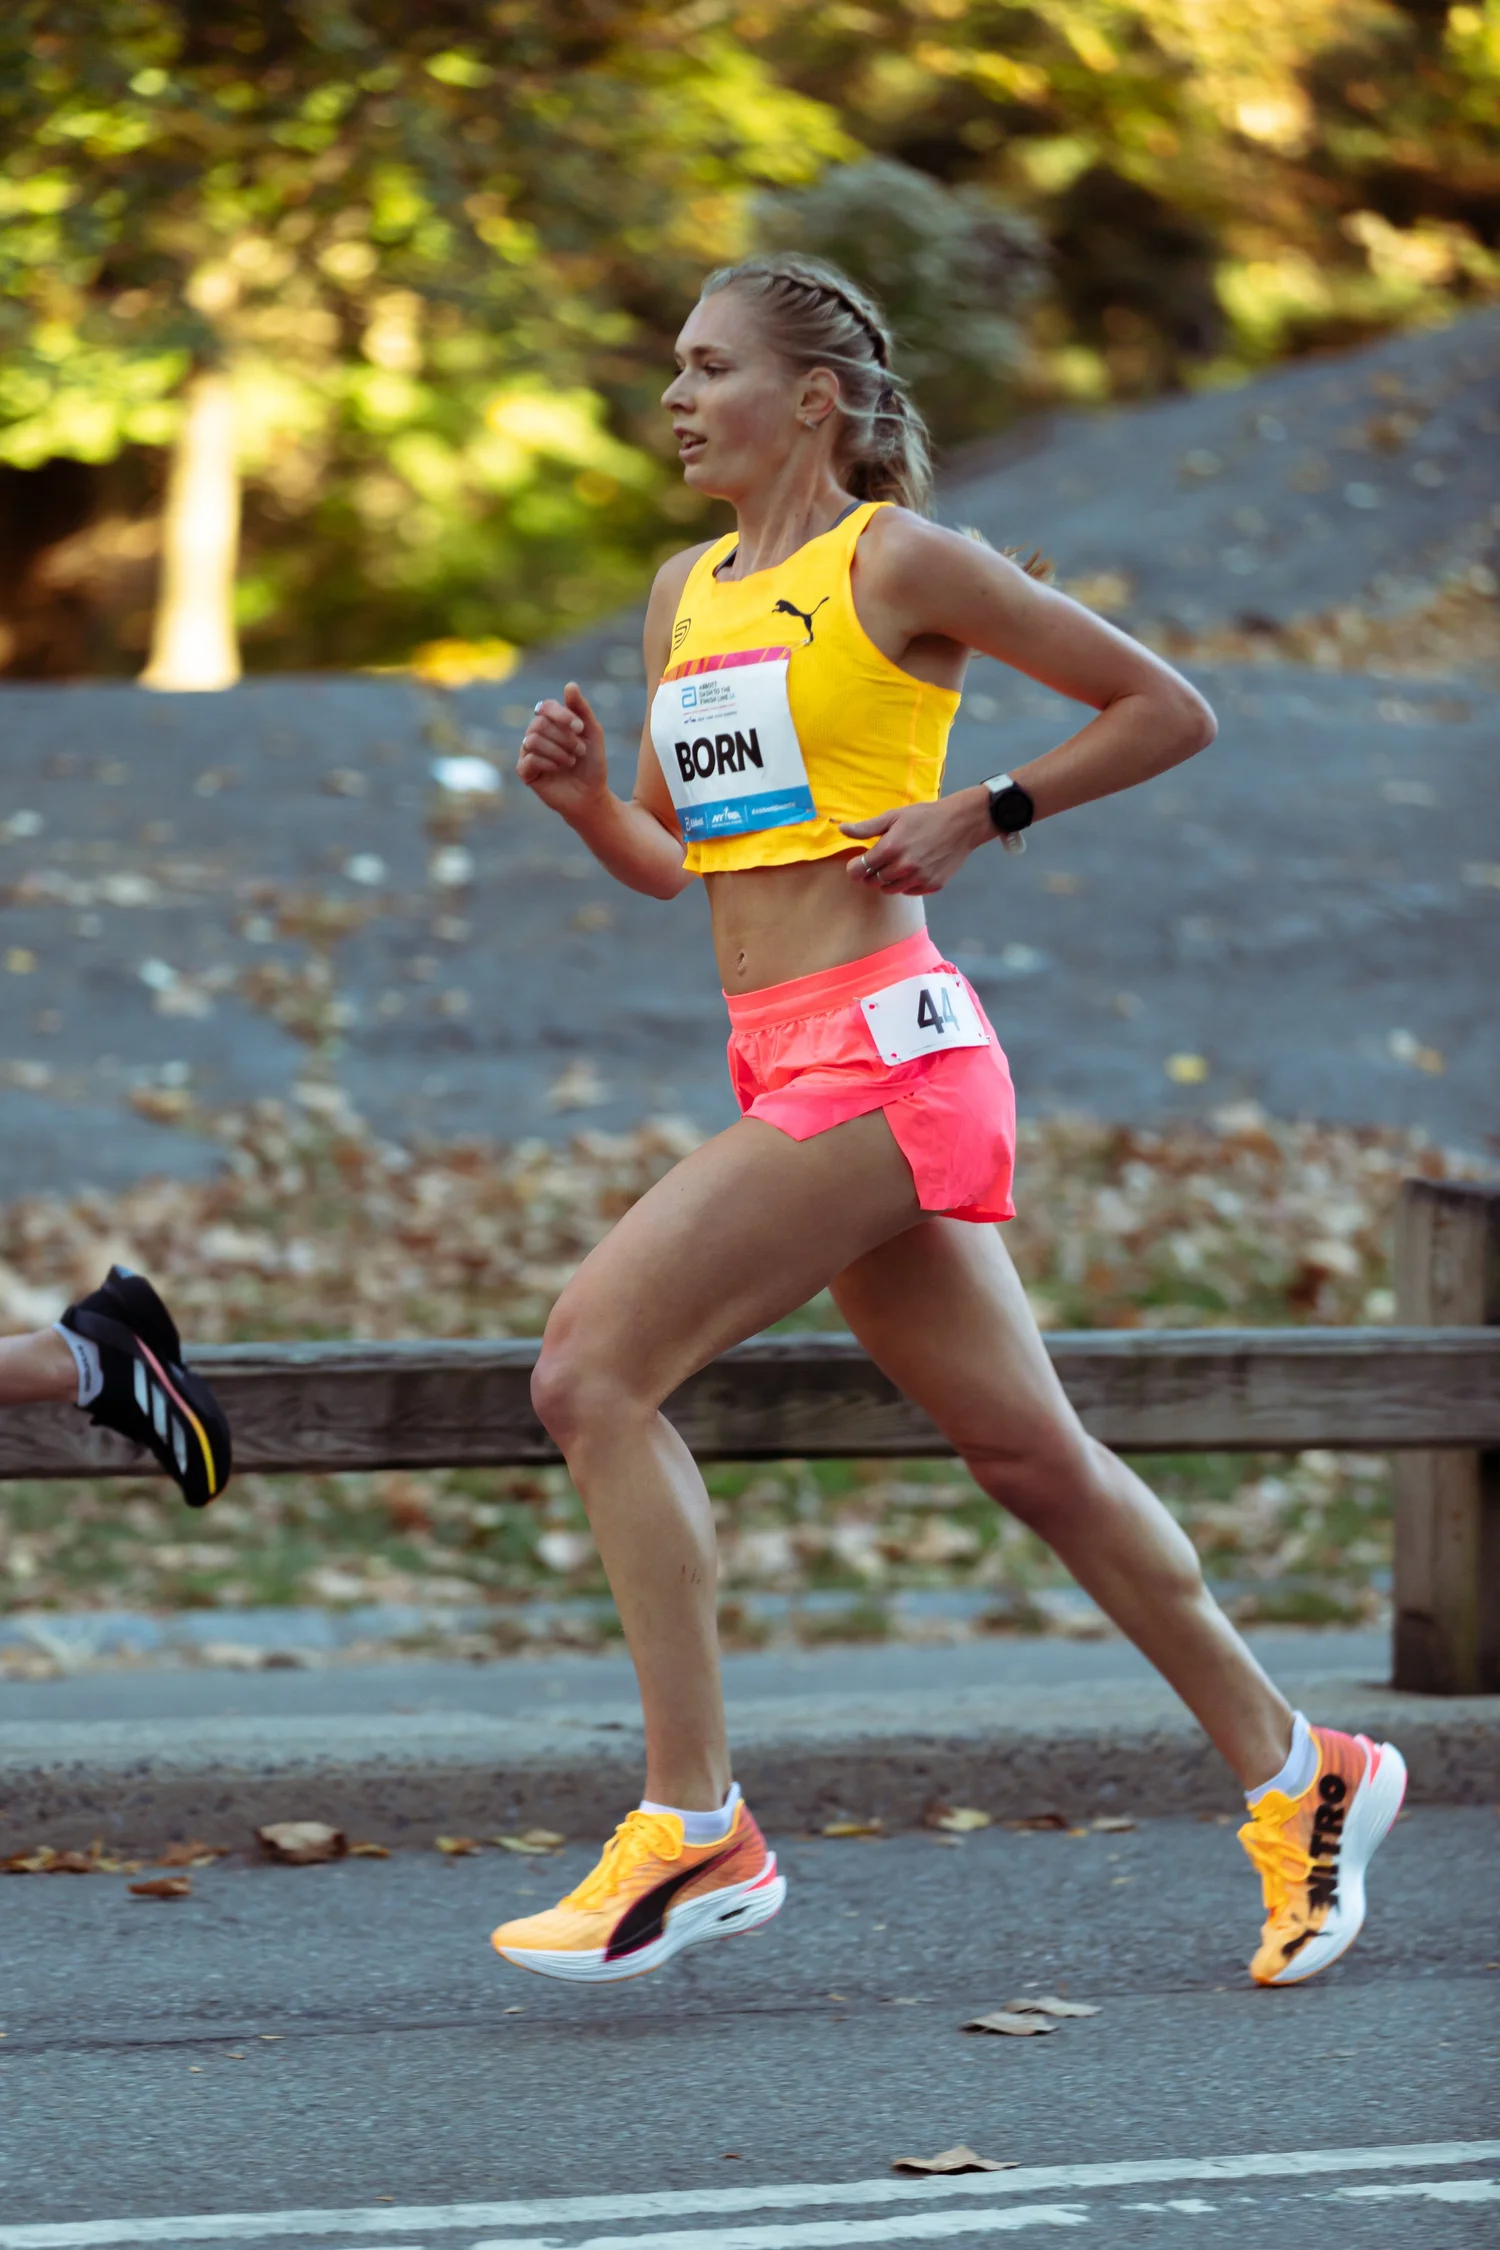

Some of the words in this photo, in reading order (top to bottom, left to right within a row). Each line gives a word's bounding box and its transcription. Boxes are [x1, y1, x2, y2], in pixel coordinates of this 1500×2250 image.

[674, 728, 764, 782] BORN
[917, 987, 960, 1034] 44
[1307, 1773, 1347, 1914] NITRO
